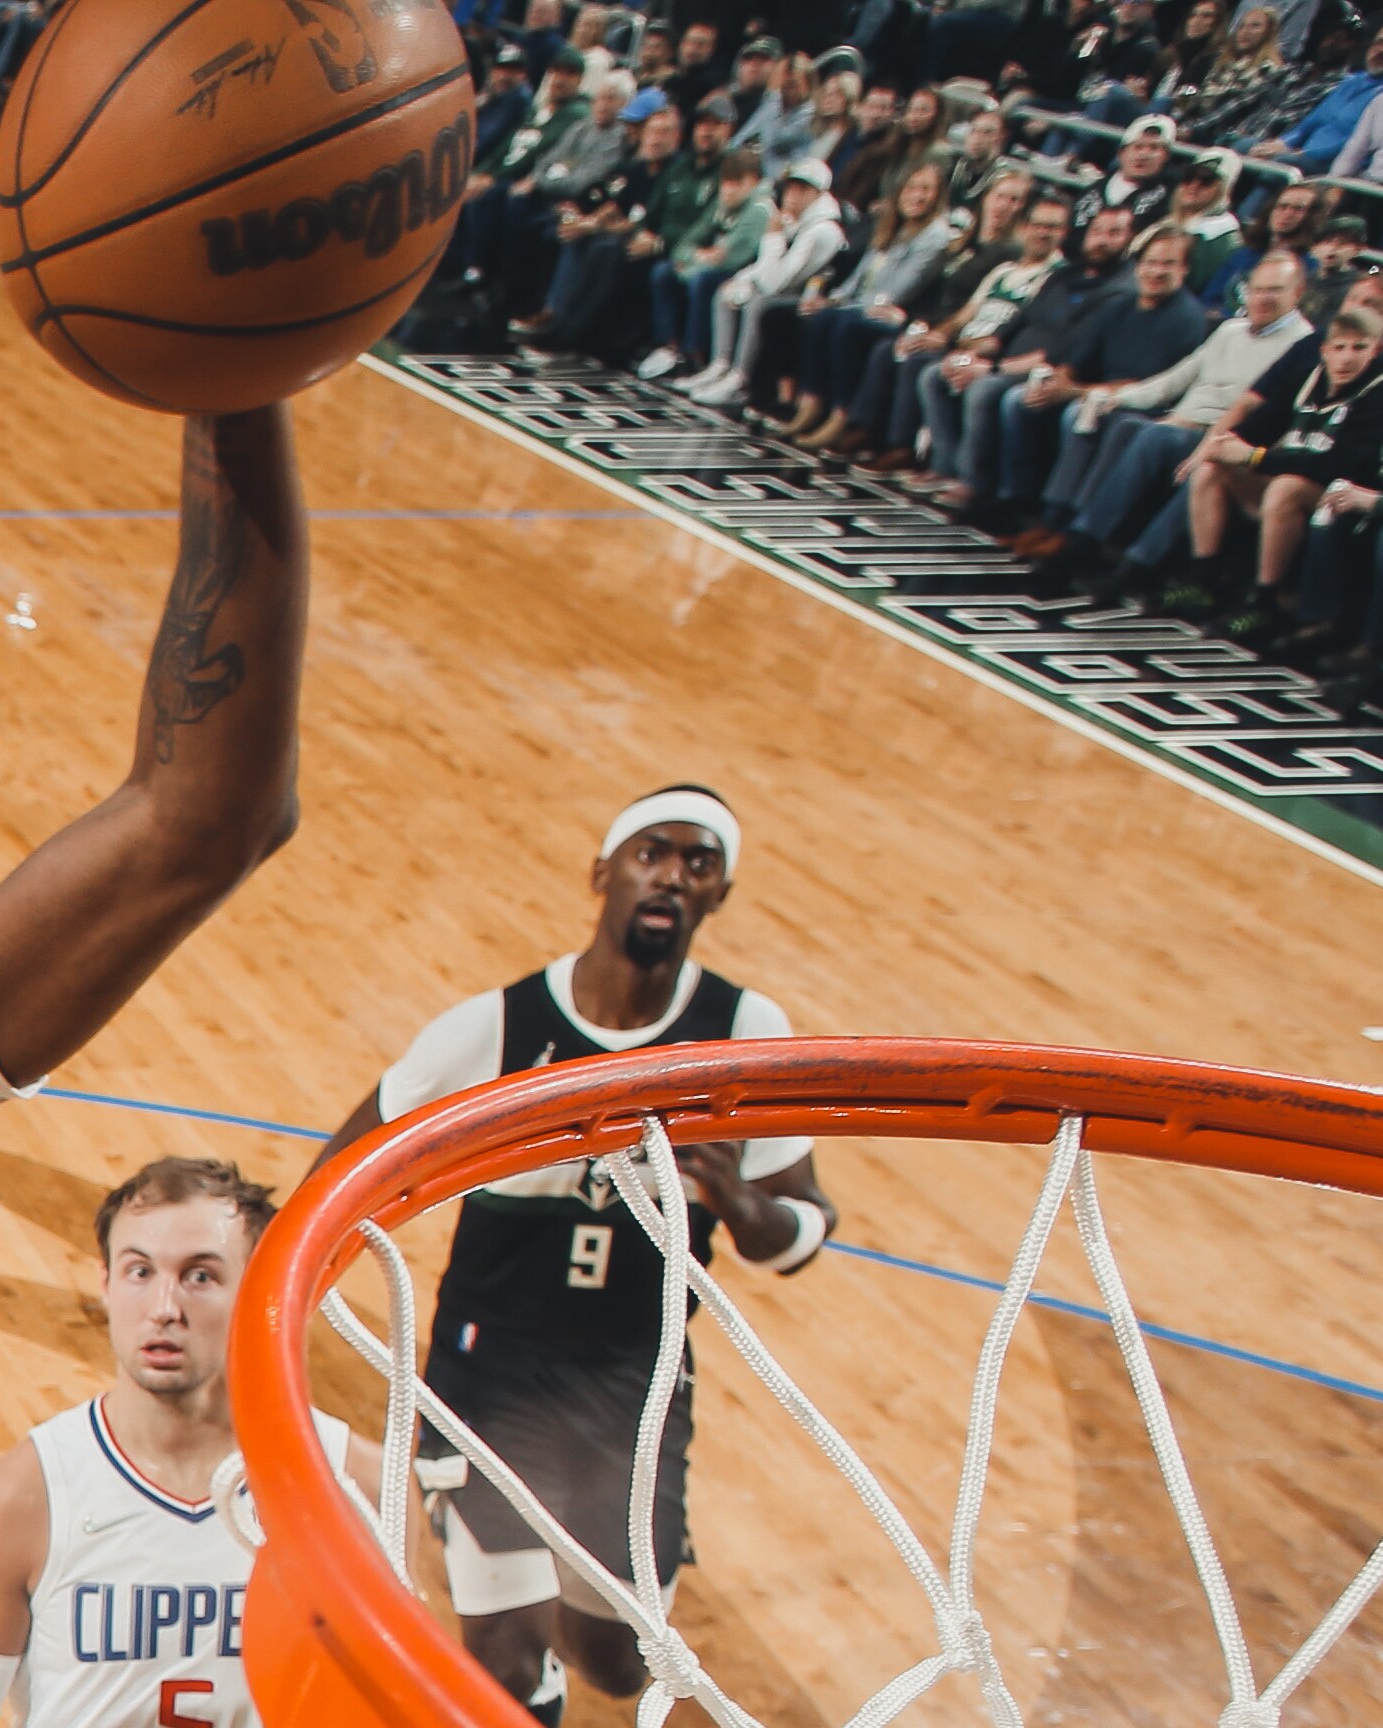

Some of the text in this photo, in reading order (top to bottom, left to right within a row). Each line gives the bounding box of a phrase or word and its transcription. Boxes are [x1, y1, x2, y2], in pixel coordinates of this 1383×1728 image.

[200, 111, 471, 276] Wilson
[567, 1224, 613, 1289] 9
[73, 1583, 248, 1663] CLIPPE
